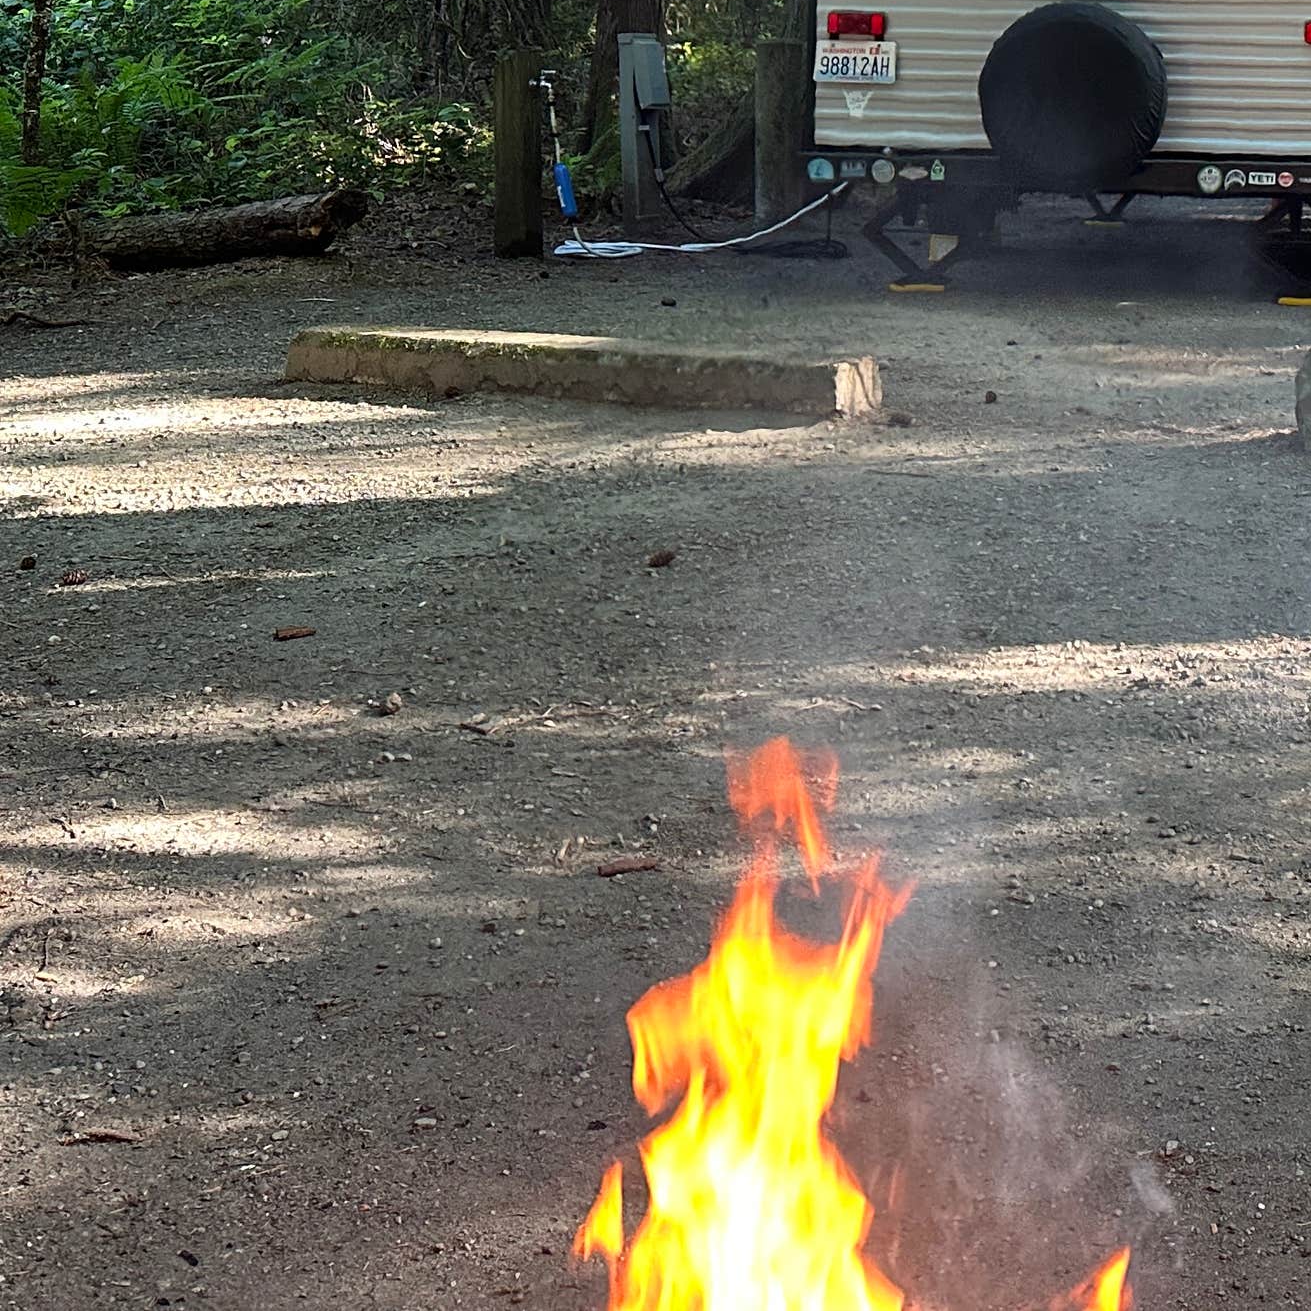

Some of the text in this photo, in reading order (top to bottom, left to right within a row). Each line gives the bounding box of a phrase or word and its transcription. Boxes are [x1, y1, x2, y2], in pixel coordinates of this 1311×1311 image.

[823, 47, 866, 55] WASHINGTON
[820, 56, 890, 76] 98812AH
[1250, 174, 1274, 183] YETI
